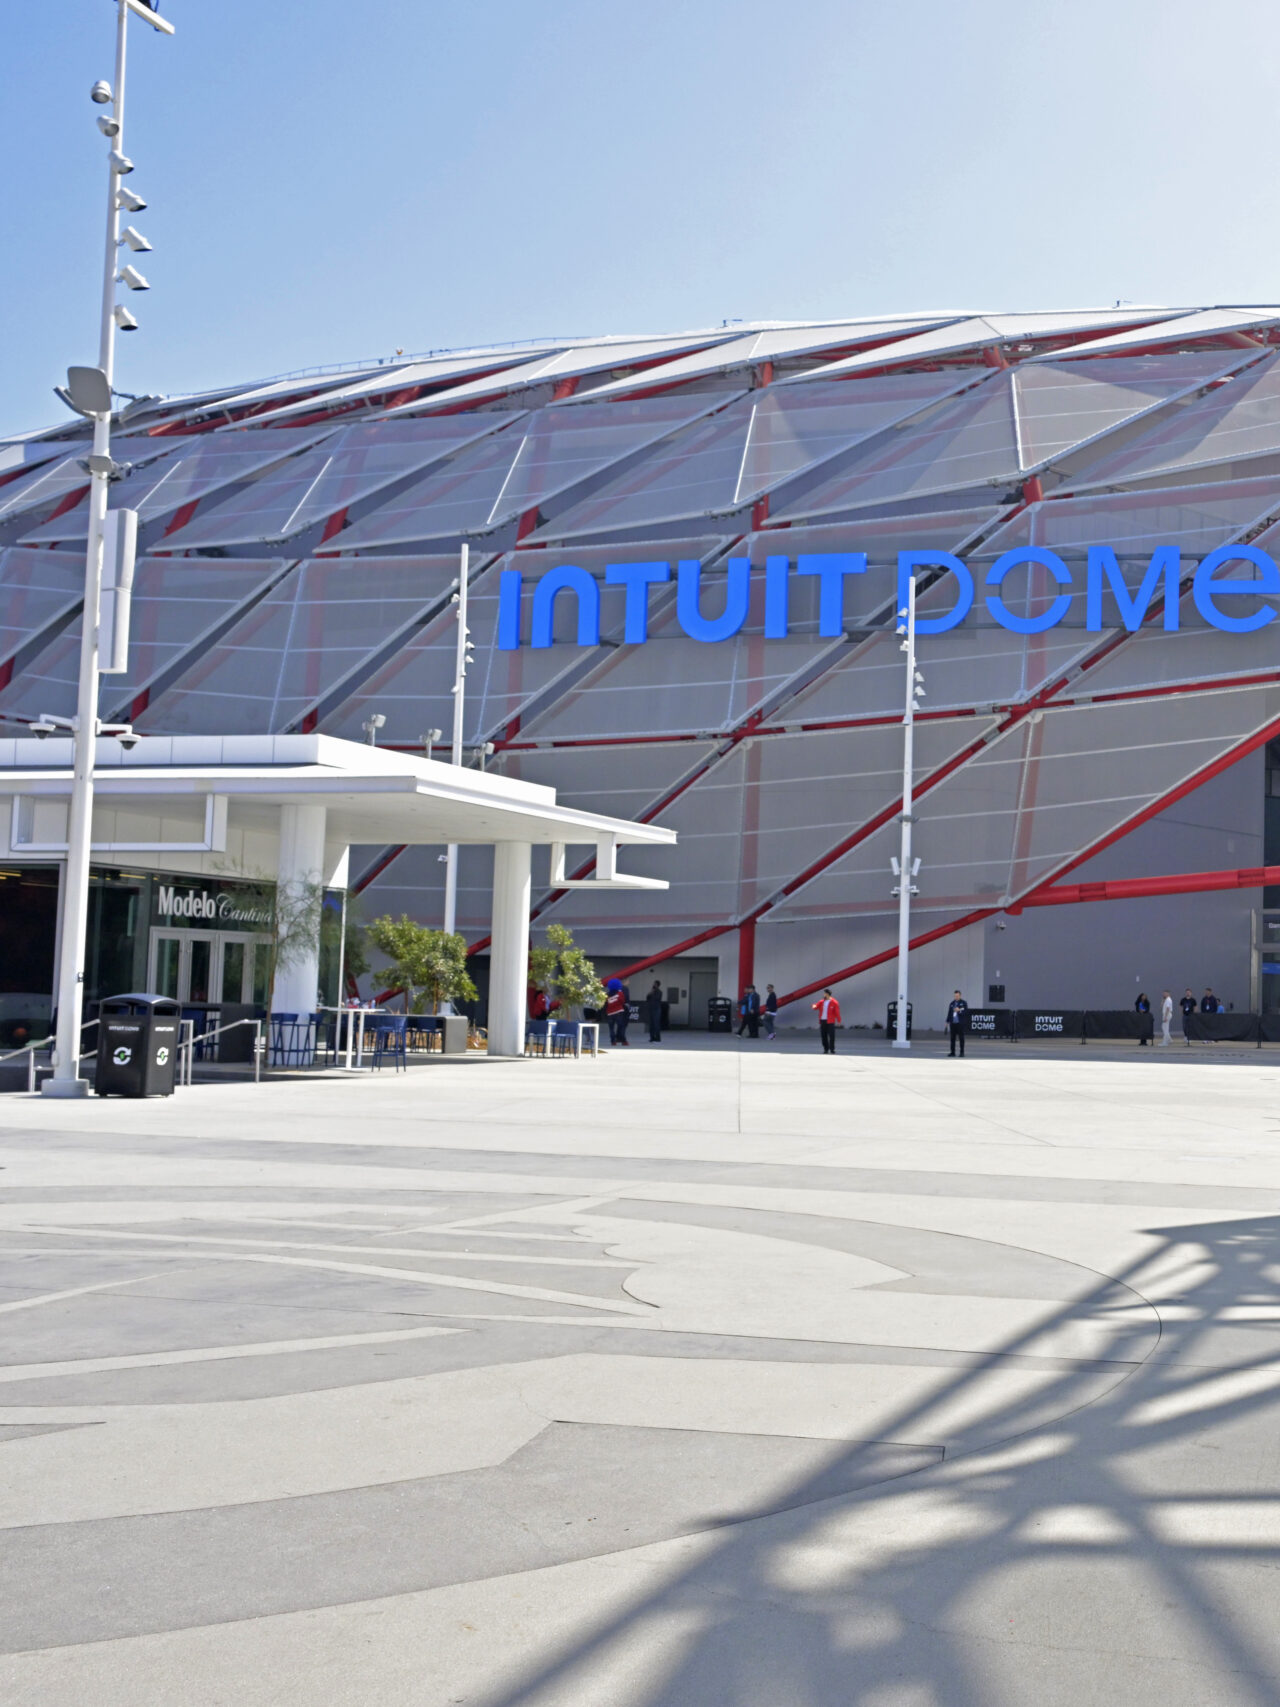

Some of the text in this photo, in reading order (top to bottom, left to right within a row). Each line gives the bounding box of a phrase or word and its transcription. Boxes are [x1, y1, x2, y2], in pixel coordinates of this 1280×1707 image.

[500, 543, 1280, 650] INTUIT DOME
[158, 885, 216, 919] Modelo
